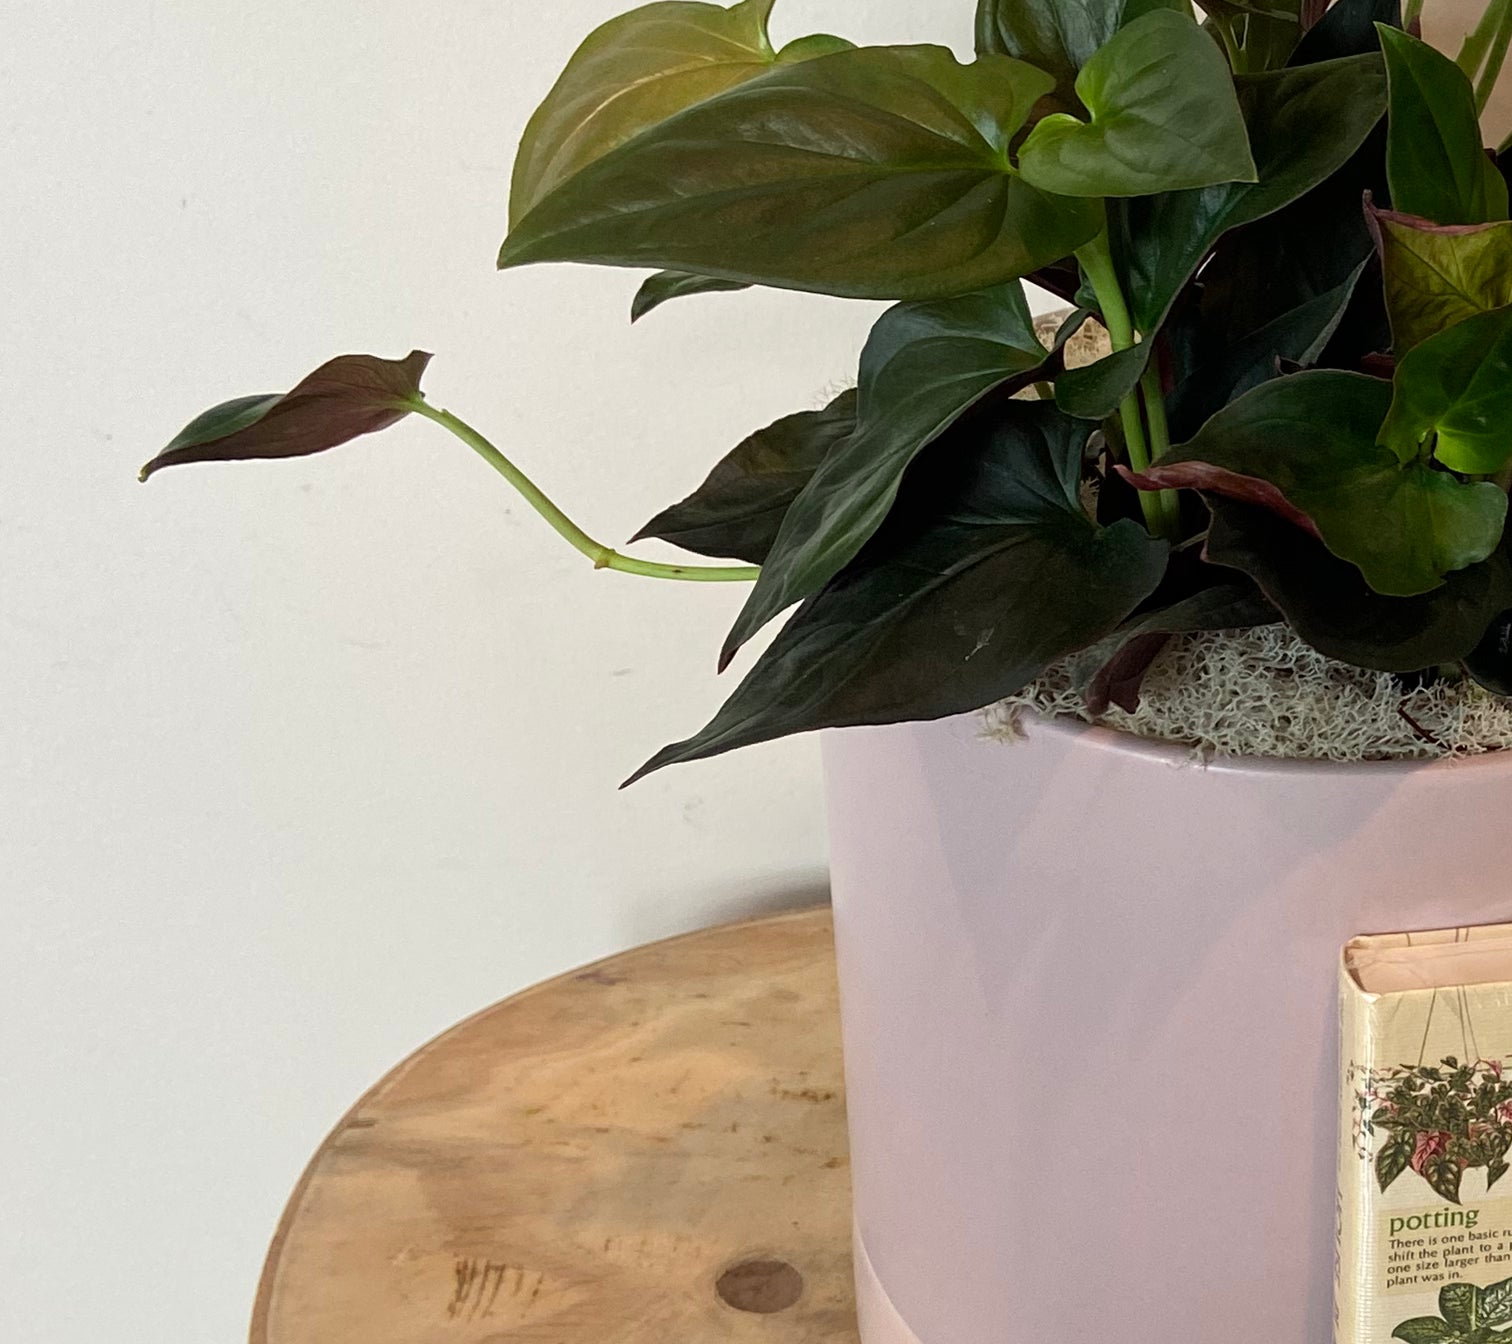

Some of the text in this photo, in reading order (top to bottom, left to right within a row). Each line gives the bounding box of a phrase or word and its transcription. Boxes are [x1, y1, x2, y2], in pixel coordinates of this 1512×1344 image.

[1389, 1207, 1480, 1236] potting
[1389, 1237, 1425, 1250] There
[1428, 1235, 1437, 1246] is
[1441, 1233, 1465, 1244] one
[1468, 1230, 1499, 1242] basic
[1388, 1250, 1415, 1263] shift
[1418, 1248, 1438, 1259] the
[1443, 1244, 1474, 1259] plant
[1479, 1243, 1491, 1253] to
[1497, 1242, 1504, 1251] a
[1387, 1264, 1411, 1274] one
[1416, 1260, 1439, 1272] size
[1445, 1256, 1480, 1269] larger
[1484, 1253, 1511, 1263] than
[1387, 1271, 1463, 1288] plant was in.
